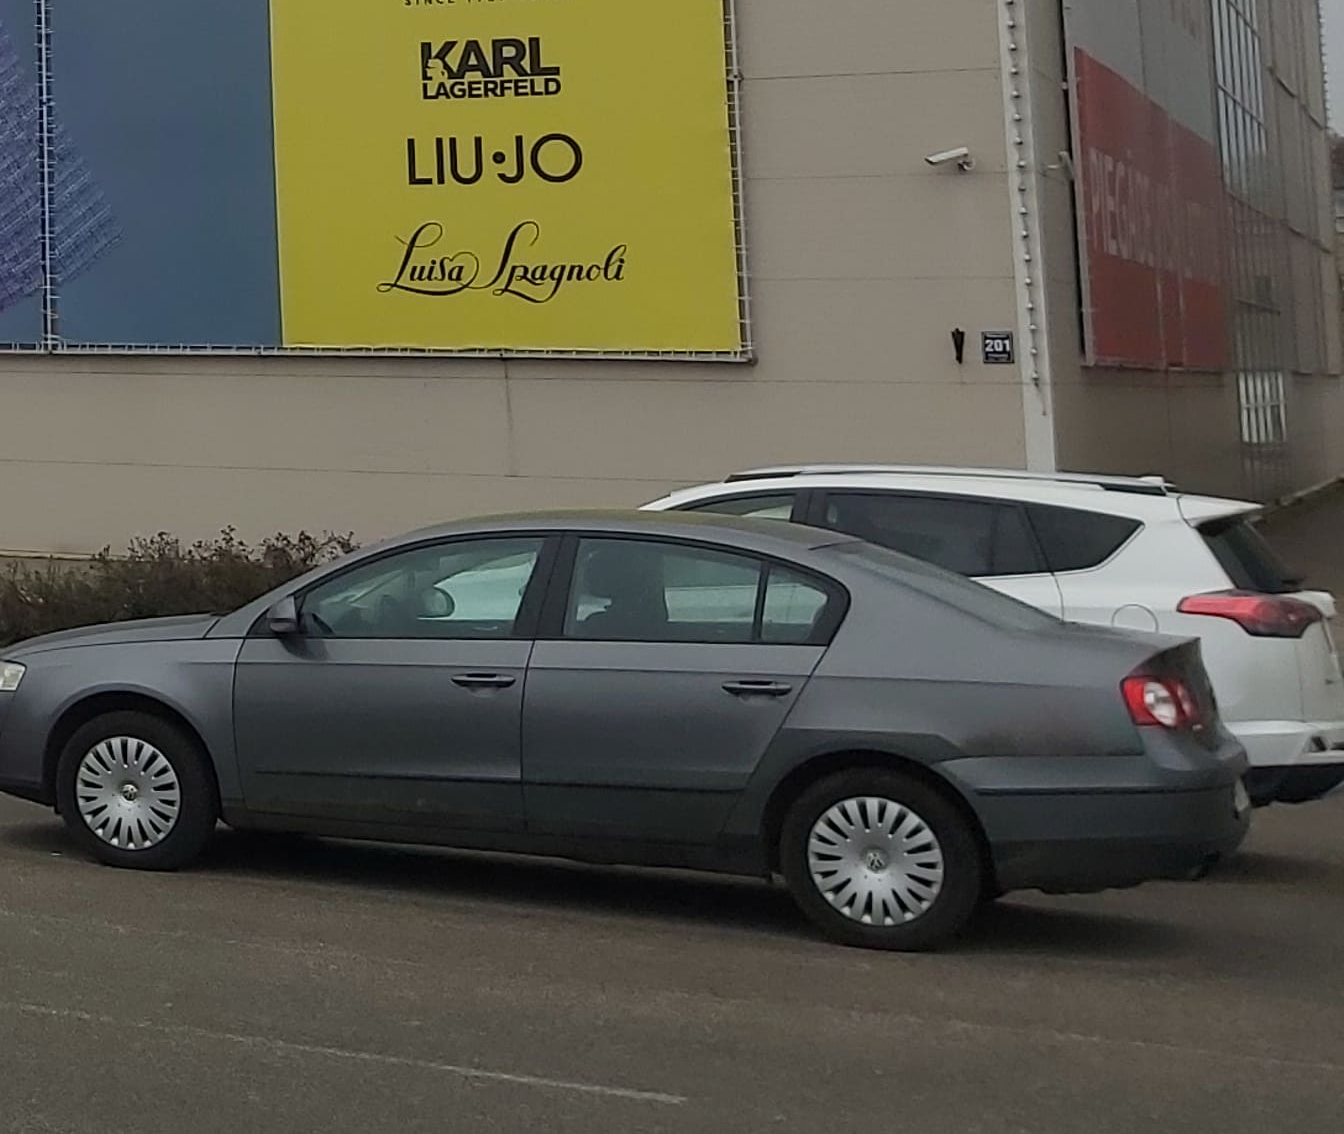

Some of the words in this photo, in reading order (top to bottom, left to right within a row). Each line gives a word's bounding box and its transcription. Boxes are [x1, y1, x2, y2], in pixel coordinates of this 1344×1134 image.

[420, 36, 561, 80] KARL
[422, 77, 562, 100] LAGERFELD
[376, 222, 479, 297] Luisa
[489, 220, 627, 304] Spagnoli
[985, 339, 1010, 352] 201
